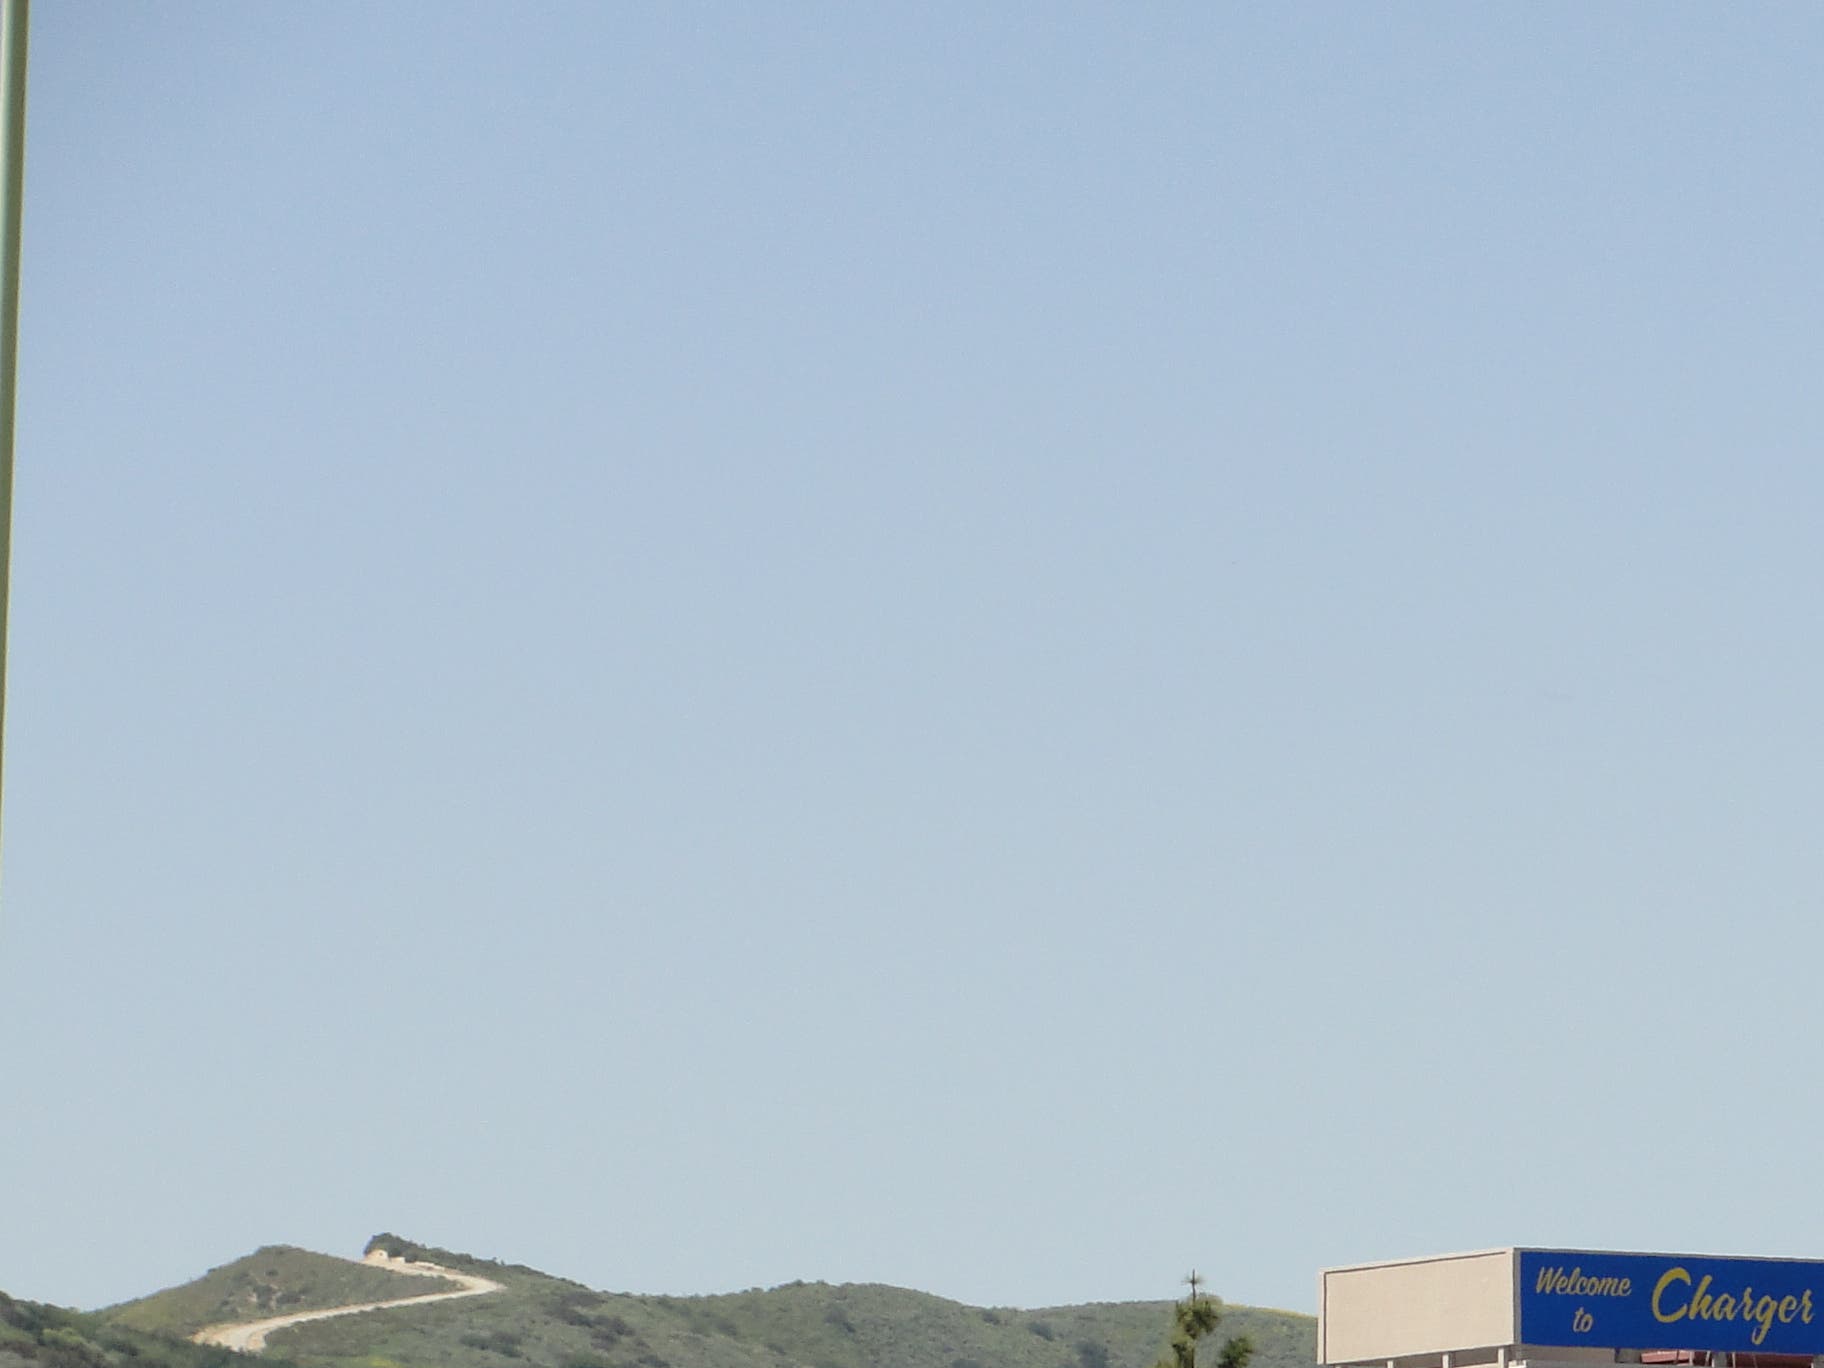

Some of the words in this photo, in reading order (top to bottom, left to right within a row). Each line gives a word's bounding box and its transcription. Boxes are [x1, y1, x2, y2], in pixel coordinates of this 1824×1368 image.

[1535, 1266, 1632, 1297] Welcome
[1571, 1307, 1595, 1333] to
[1651, 1266, 1814, 1345] Charger
